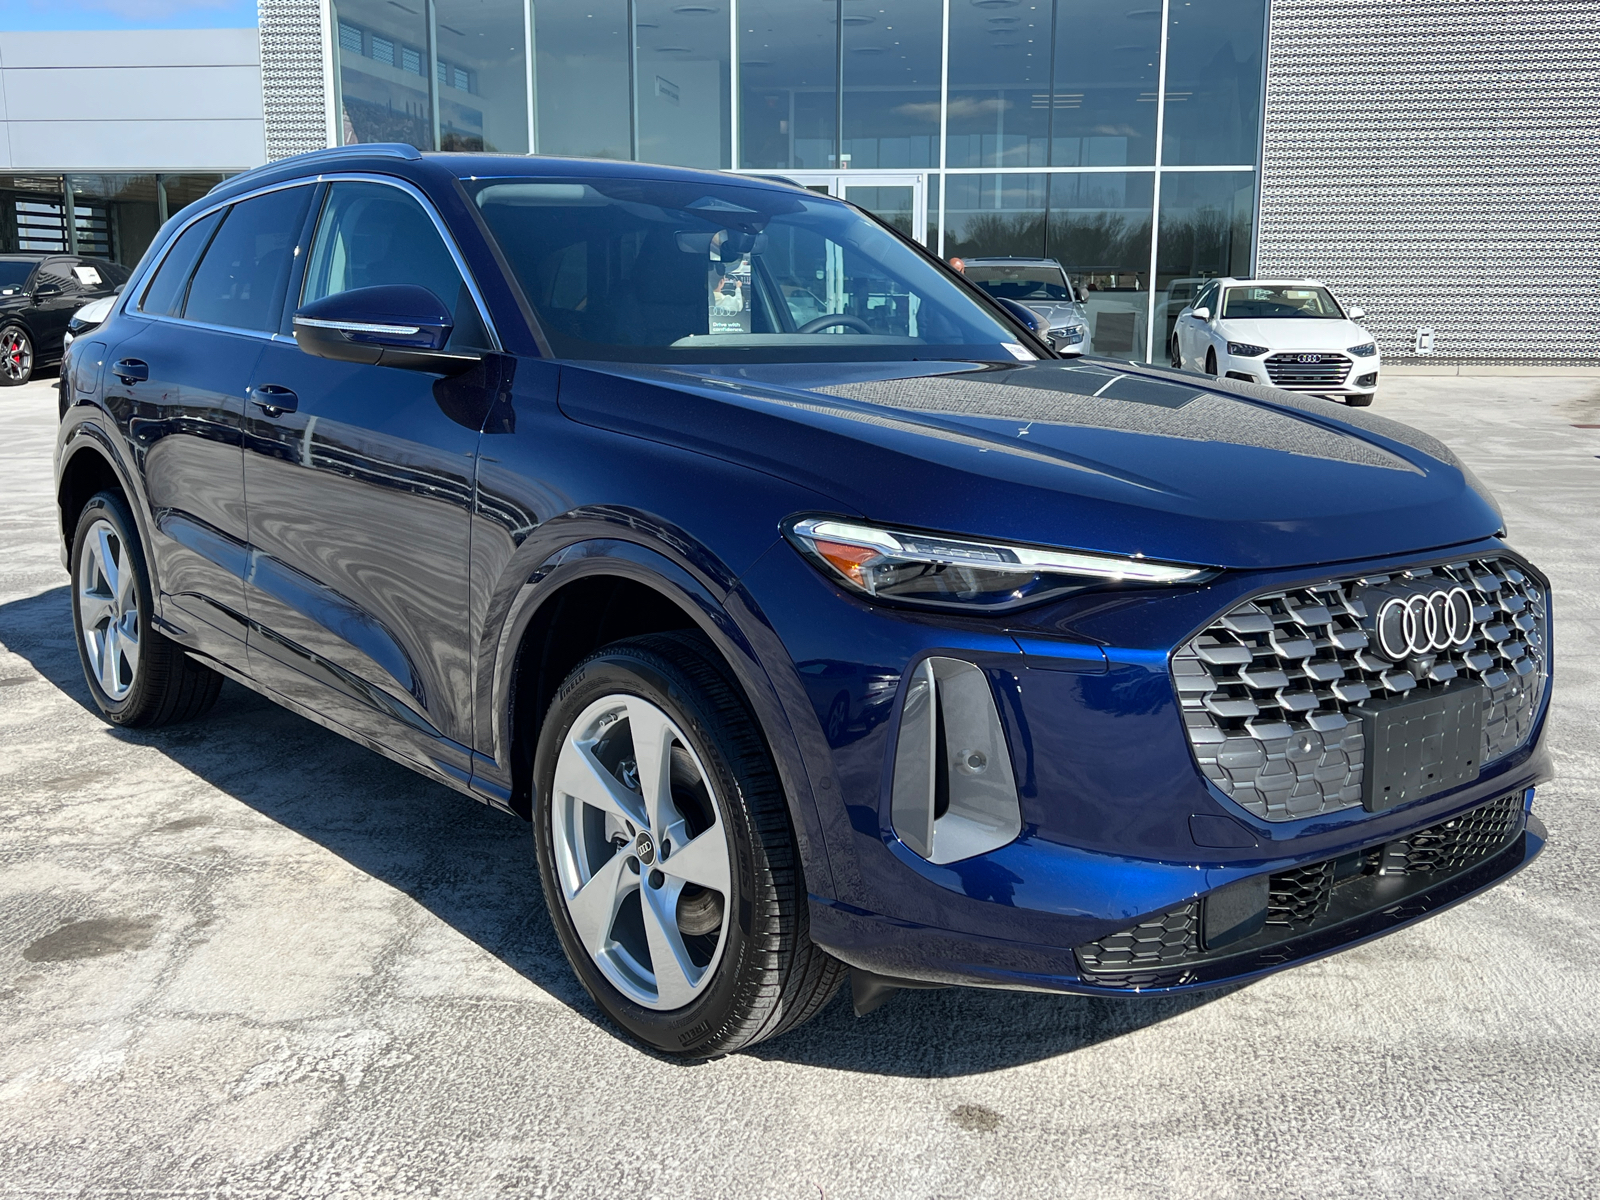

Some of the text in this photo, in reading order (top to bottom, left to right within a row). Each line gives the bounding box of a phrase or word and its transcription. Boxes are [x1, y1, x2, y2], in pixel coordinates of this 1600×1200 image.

[560, 667, 586, 701] PIRELLI
[689, 715, 752, 891] SCORPION MS
[677, 1019, 714, 1047] PIRELLI
